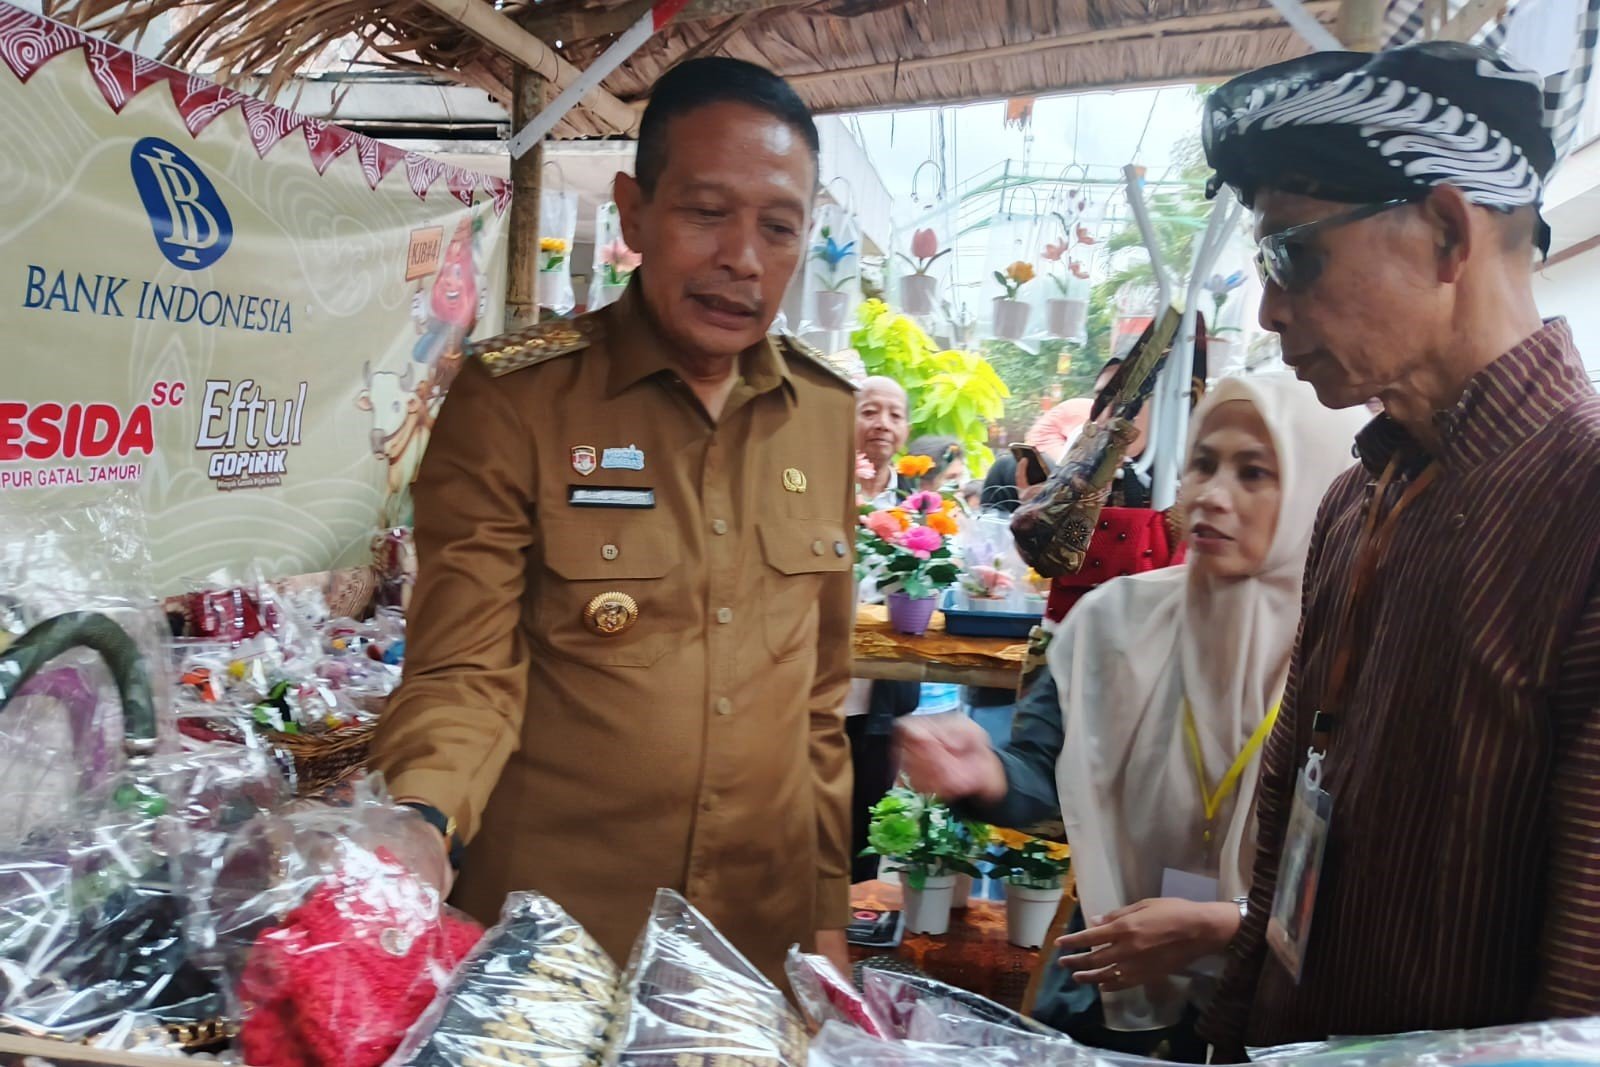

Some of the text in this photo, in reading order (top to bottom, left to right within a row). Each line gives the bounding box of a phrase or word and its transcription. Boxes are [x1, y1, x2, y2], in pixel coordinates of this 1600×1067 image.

[22, 265, 292, 333] BANK INDONESIA
[151, 381, 185, 406] SC
[195, 379, 307, 449] Eftul
[0, 464, 141, 488] PUR GATAL JAMUR!
